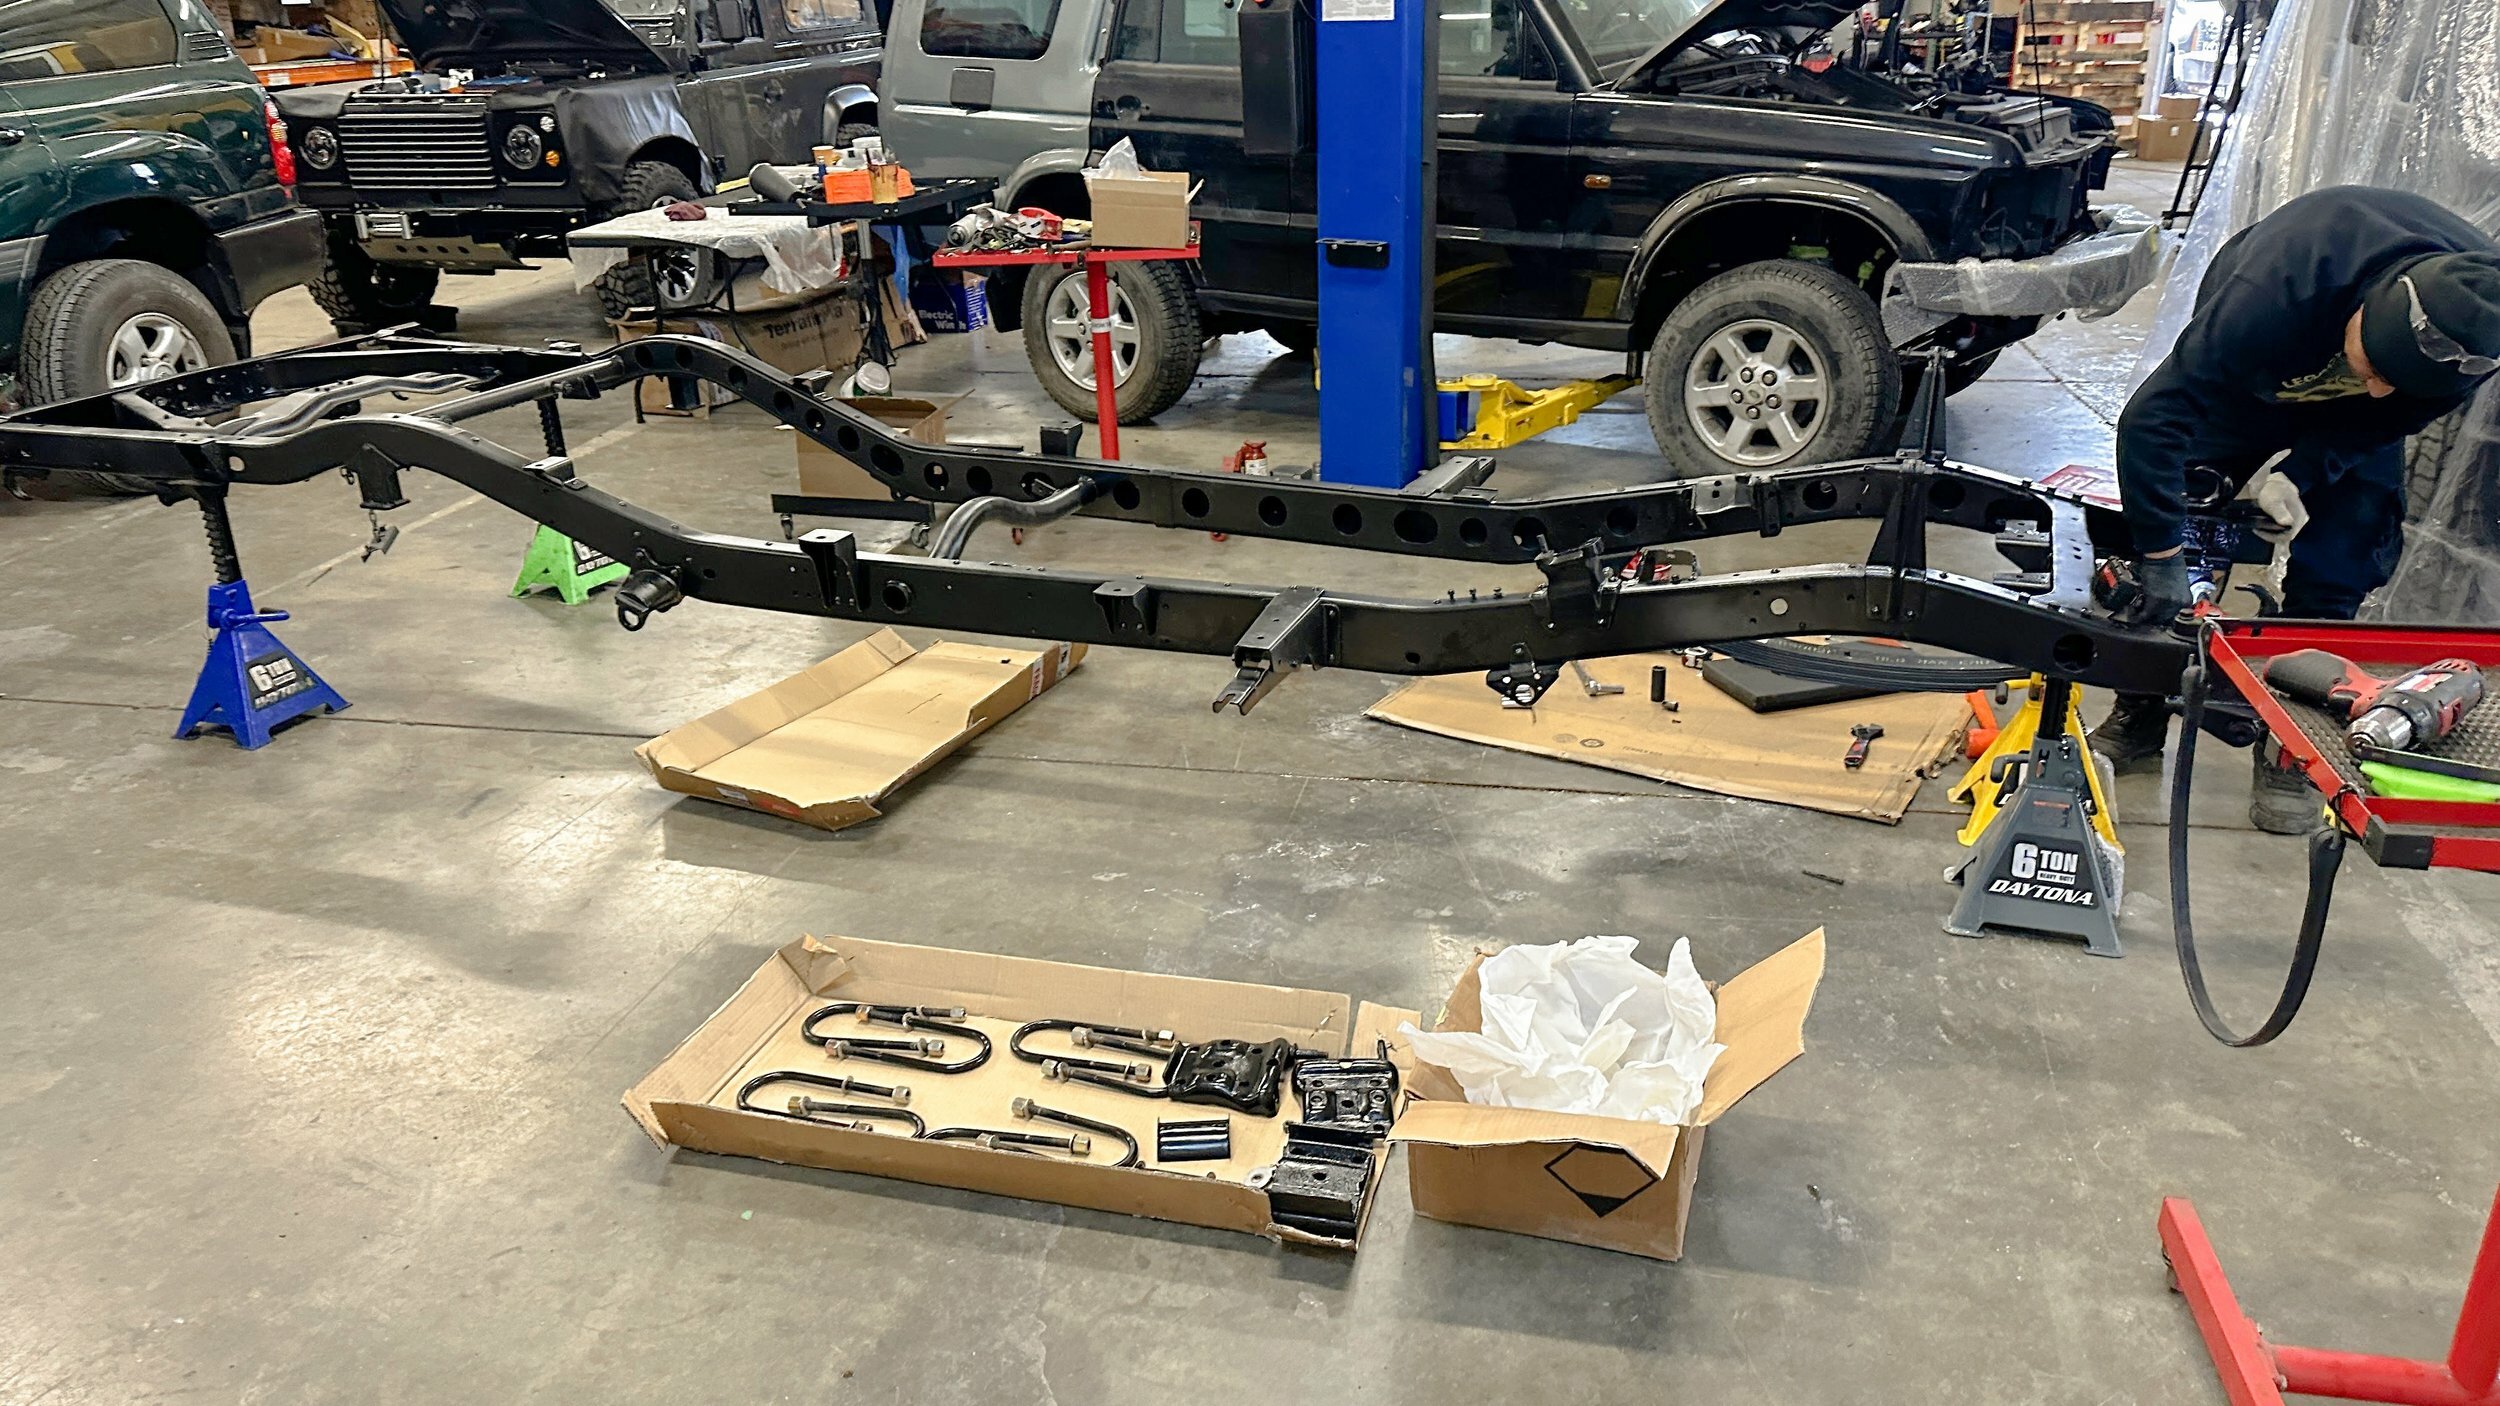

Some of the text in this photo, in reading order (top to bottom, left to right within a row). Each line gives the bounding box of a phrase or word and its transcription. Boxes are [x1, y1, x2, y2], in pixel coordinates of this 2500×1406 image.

[919, 309, 954, 320] Electric
[935, 320, 967, 330] Winh
[249, 664, 274, 691] 6
[2011, 842, 2078, 878] 6 TON
[1988, 879, 2094, 906] DAYTONA
